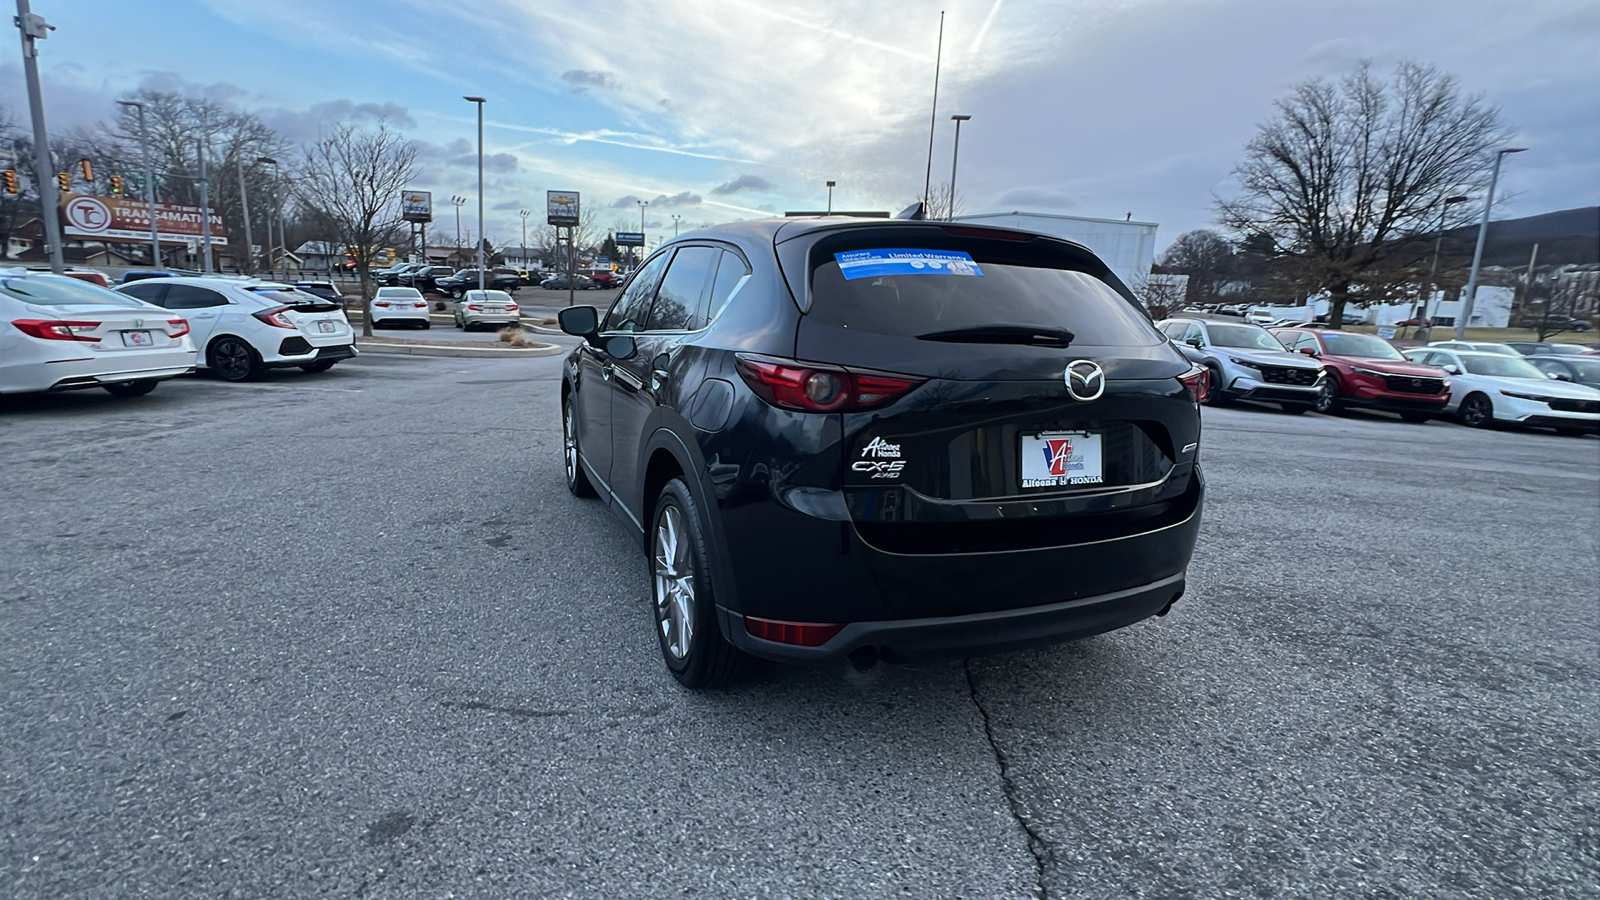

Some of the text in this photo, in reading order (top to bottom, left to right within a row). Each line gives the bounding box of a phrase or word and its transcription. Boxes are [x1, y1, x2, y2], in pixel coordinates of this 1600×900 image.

[888, 252, 967, 262] Limited Warranty
[851, 460, 907, 472] CX-5
[1022, 476, 1104, 488] Altoona HONDA
